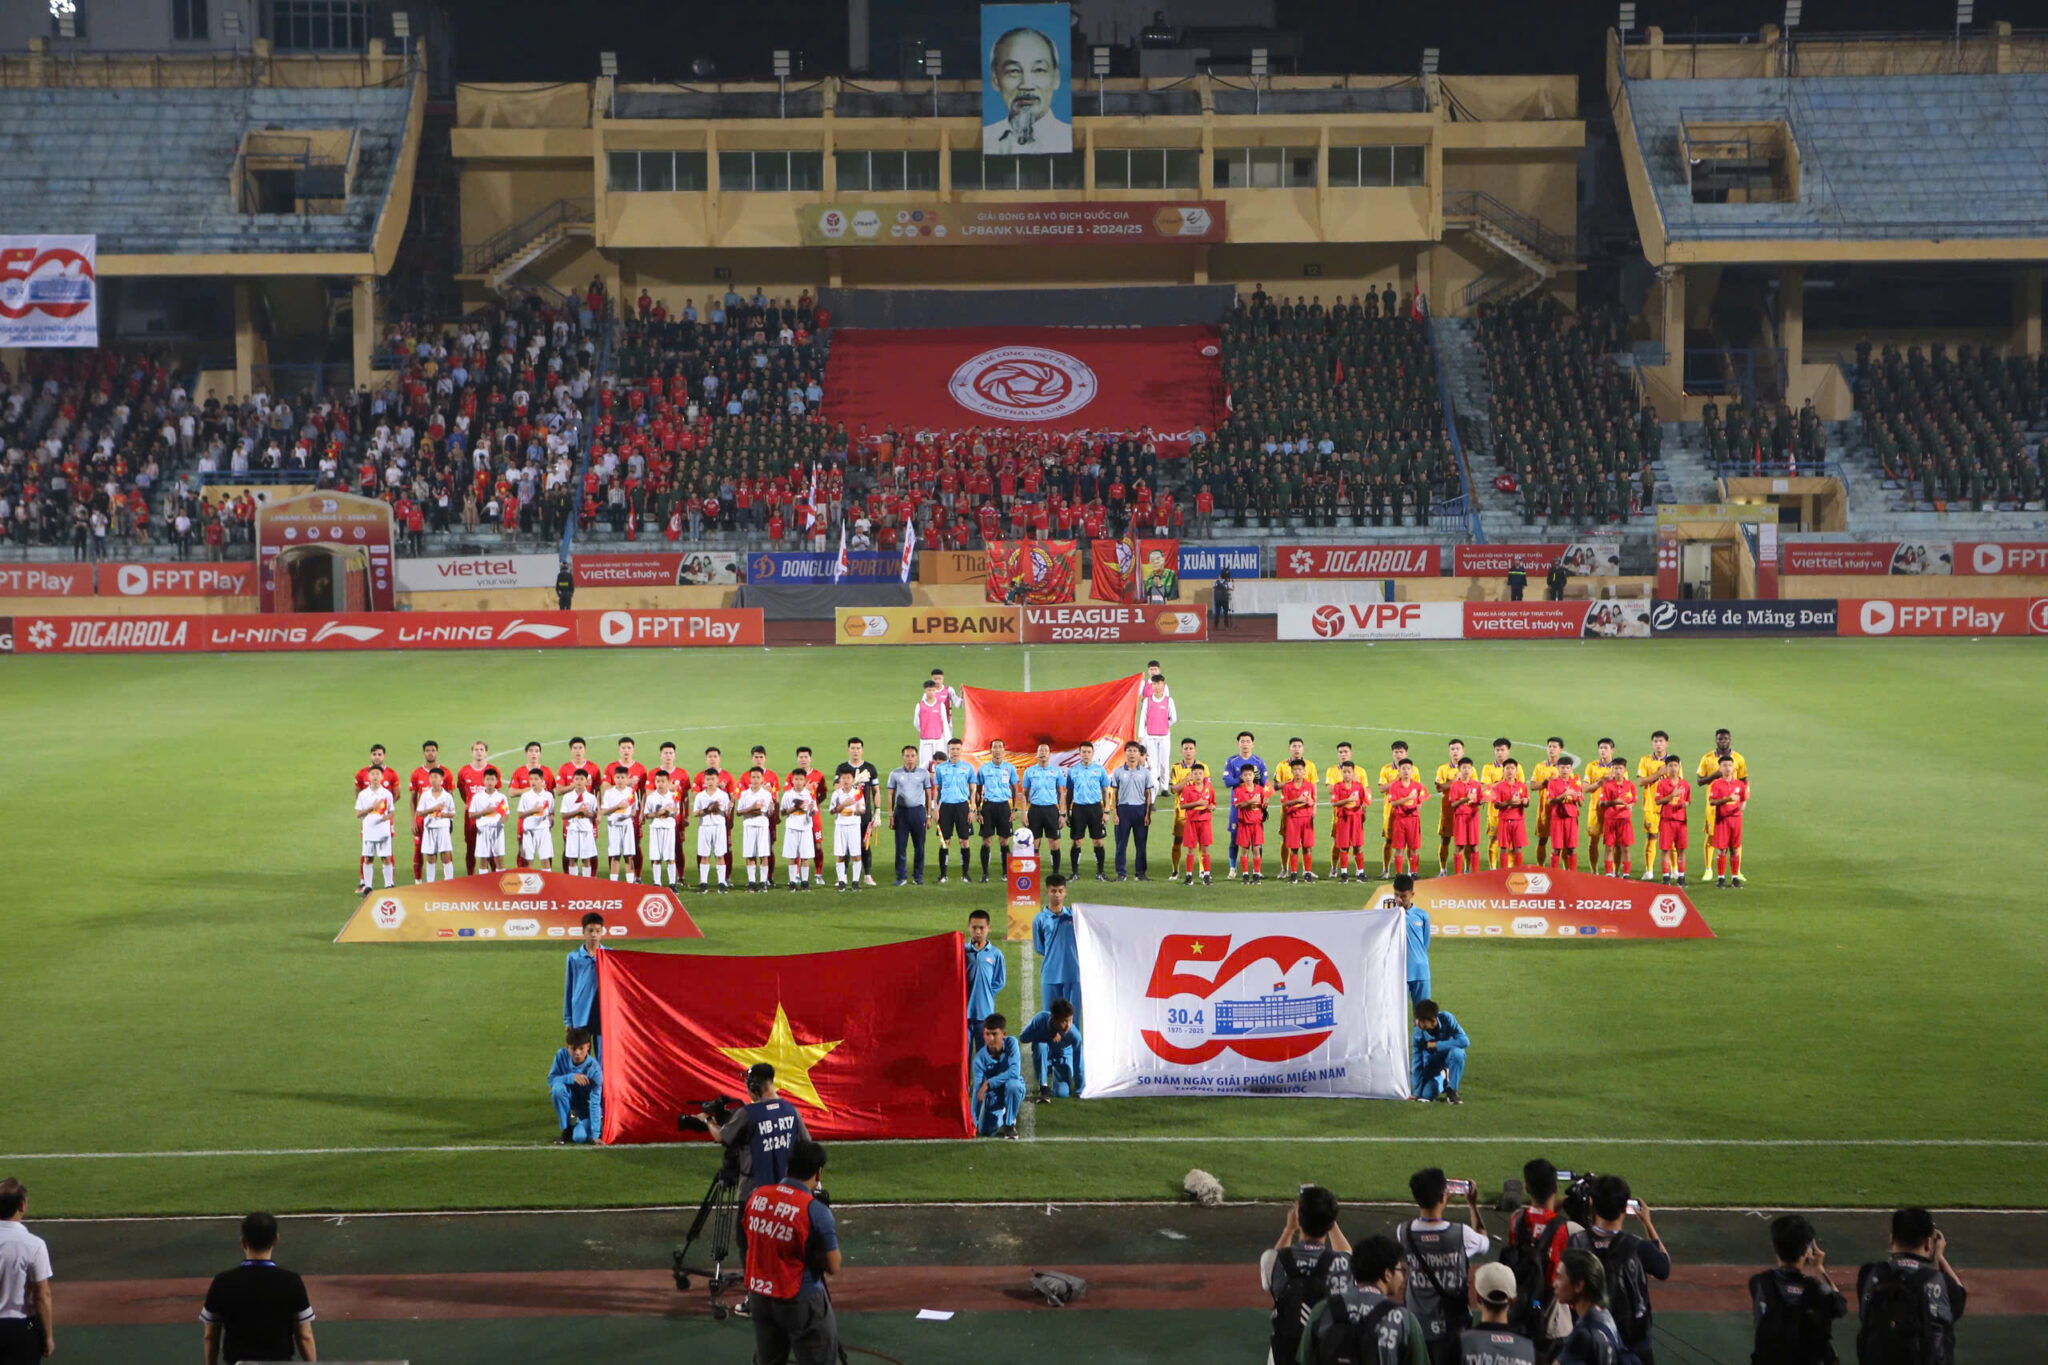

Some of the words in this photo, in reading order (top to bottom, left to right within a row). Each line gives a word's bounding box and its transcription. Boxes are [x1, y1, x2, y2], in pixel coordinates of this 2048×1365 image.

[962, 226, 1013, 235] LPBANK
[1015, 225, 1074, 235] V.LEAGUE
[1077, 225, 1084, 234] 1
[1092, 225, 1143, 235] 2024/25
[1183, 550, 1216, 570] XUÂN
[1218, 550, 1257, 570] THÀNH
[1319, 550, 1427, 573] JOGARBOLA
[1462, 559, 1511, 570] viettel
[1792, 557, 1842, 568] viettel
[2008, 548, 2048, 569] FPT
[437, 559, 517, 577] viettel
[580, 568, 632, 579] viettel
[632, 570, 657, 580] study
[26, 570, 74, 595] Play
[153, 570, 194, 590] FPT
[198, 570, 246, 594] Play
[912, 616, 1015, 634] LPBANK
[1026, 608, 1129, 625] V.LEAGUE
[1134, 608, 1146, 624] 1
[1349, 604, 1421, 629] VPF
[1472, 618, 1530, 630] viettel
[1532, 620, 1559, 631] study
[1680, 609, 1717, 625] Café
[1722, 609, 1742, 625] de
[1747, 608, 1796, 628] Măng
[1900, 606, 1948, 628] FPT
[1951, 606, 2005, 633] Play
[63, 621, 188, 648] JOGARBOLA
[211, 627, 307, 643] LI-NING
[398, 625, 494, 642] LI-NING
[638, 617, 684, 638] FPT
[689, 616, 741, 643] Play
[1052, 627, 1120, 641] 2024/25
[424, 901, 480, 912] LPBANK
[483, 900, 548, 911] V.LEAGUE
[550, 900, 558, 911] 1
[567, 900, 623, 911] 2024/25
[1430, 899, 1487, 909] LPBANK
[1490, 899, 1556, 910] V.LEAGUE
[1558, 899, 1566, 910] 1
[1576, 899, 1632, 911] 2024/25
[1168, 1008, 1204, 1025] 30.4
[1138, 1076, 1151, 1085] 50
[1154, 1074, 1180, 1085] NĂM
[1184, 1075, 1214, 1085] NGÀY
[1216, 1074, 1240, 1086] GIẢI
[1319, 1067, 1346, 1080] NAM
[758, 1119, 773, 1135] HB
[751, 1195, 768, 1212] HB
[773, 1201, 800, 1222] FPT
